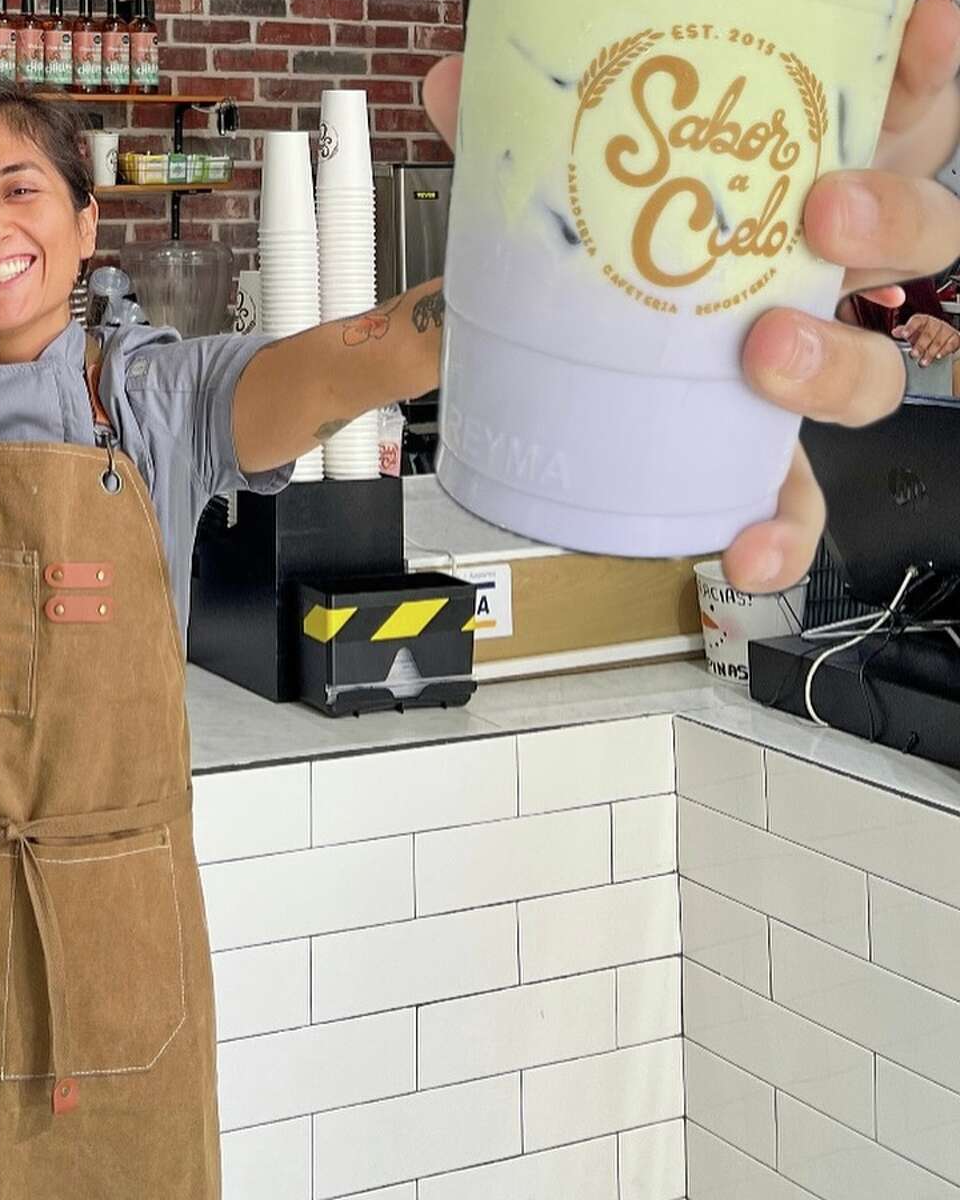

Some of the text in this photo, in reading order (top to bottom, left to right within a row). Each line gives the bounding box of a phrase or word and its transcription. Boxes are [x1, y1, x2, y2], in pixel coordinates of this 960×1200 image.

[671, 24, 776, 56] EST. 2015
[605, 55, 800, 187] Sabor
[728, 174, 749, 192] a
[632, 175, 788, 288] Cielo
[477, 595, 490, 615] A
